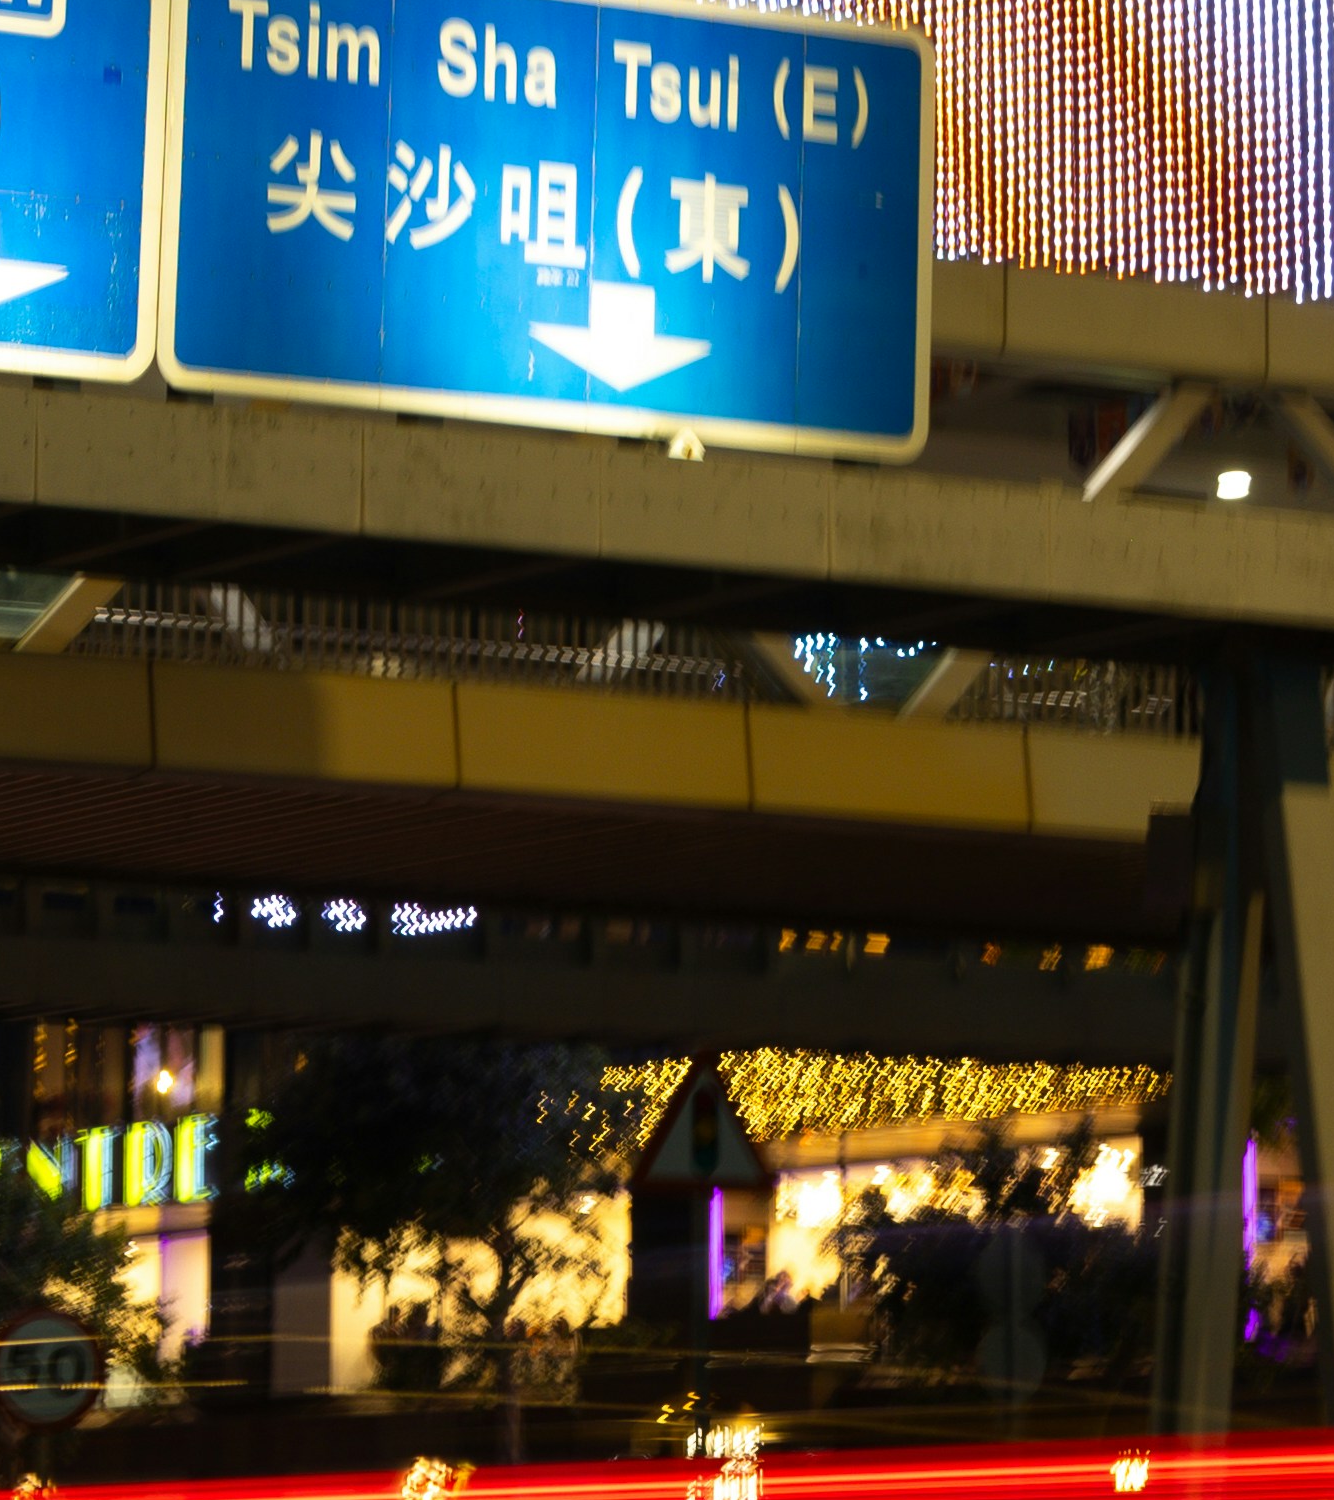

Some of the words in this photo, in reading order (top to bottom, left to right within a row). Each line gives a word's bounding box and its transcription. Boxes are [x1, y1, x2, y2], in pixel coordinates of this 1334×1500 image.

[437, 18, 557, 110] Sha
[613, 40, 739, 133] Tsui
[773, 57, 869, 150] (E)
[8, 1345, 86, 1397] 50
